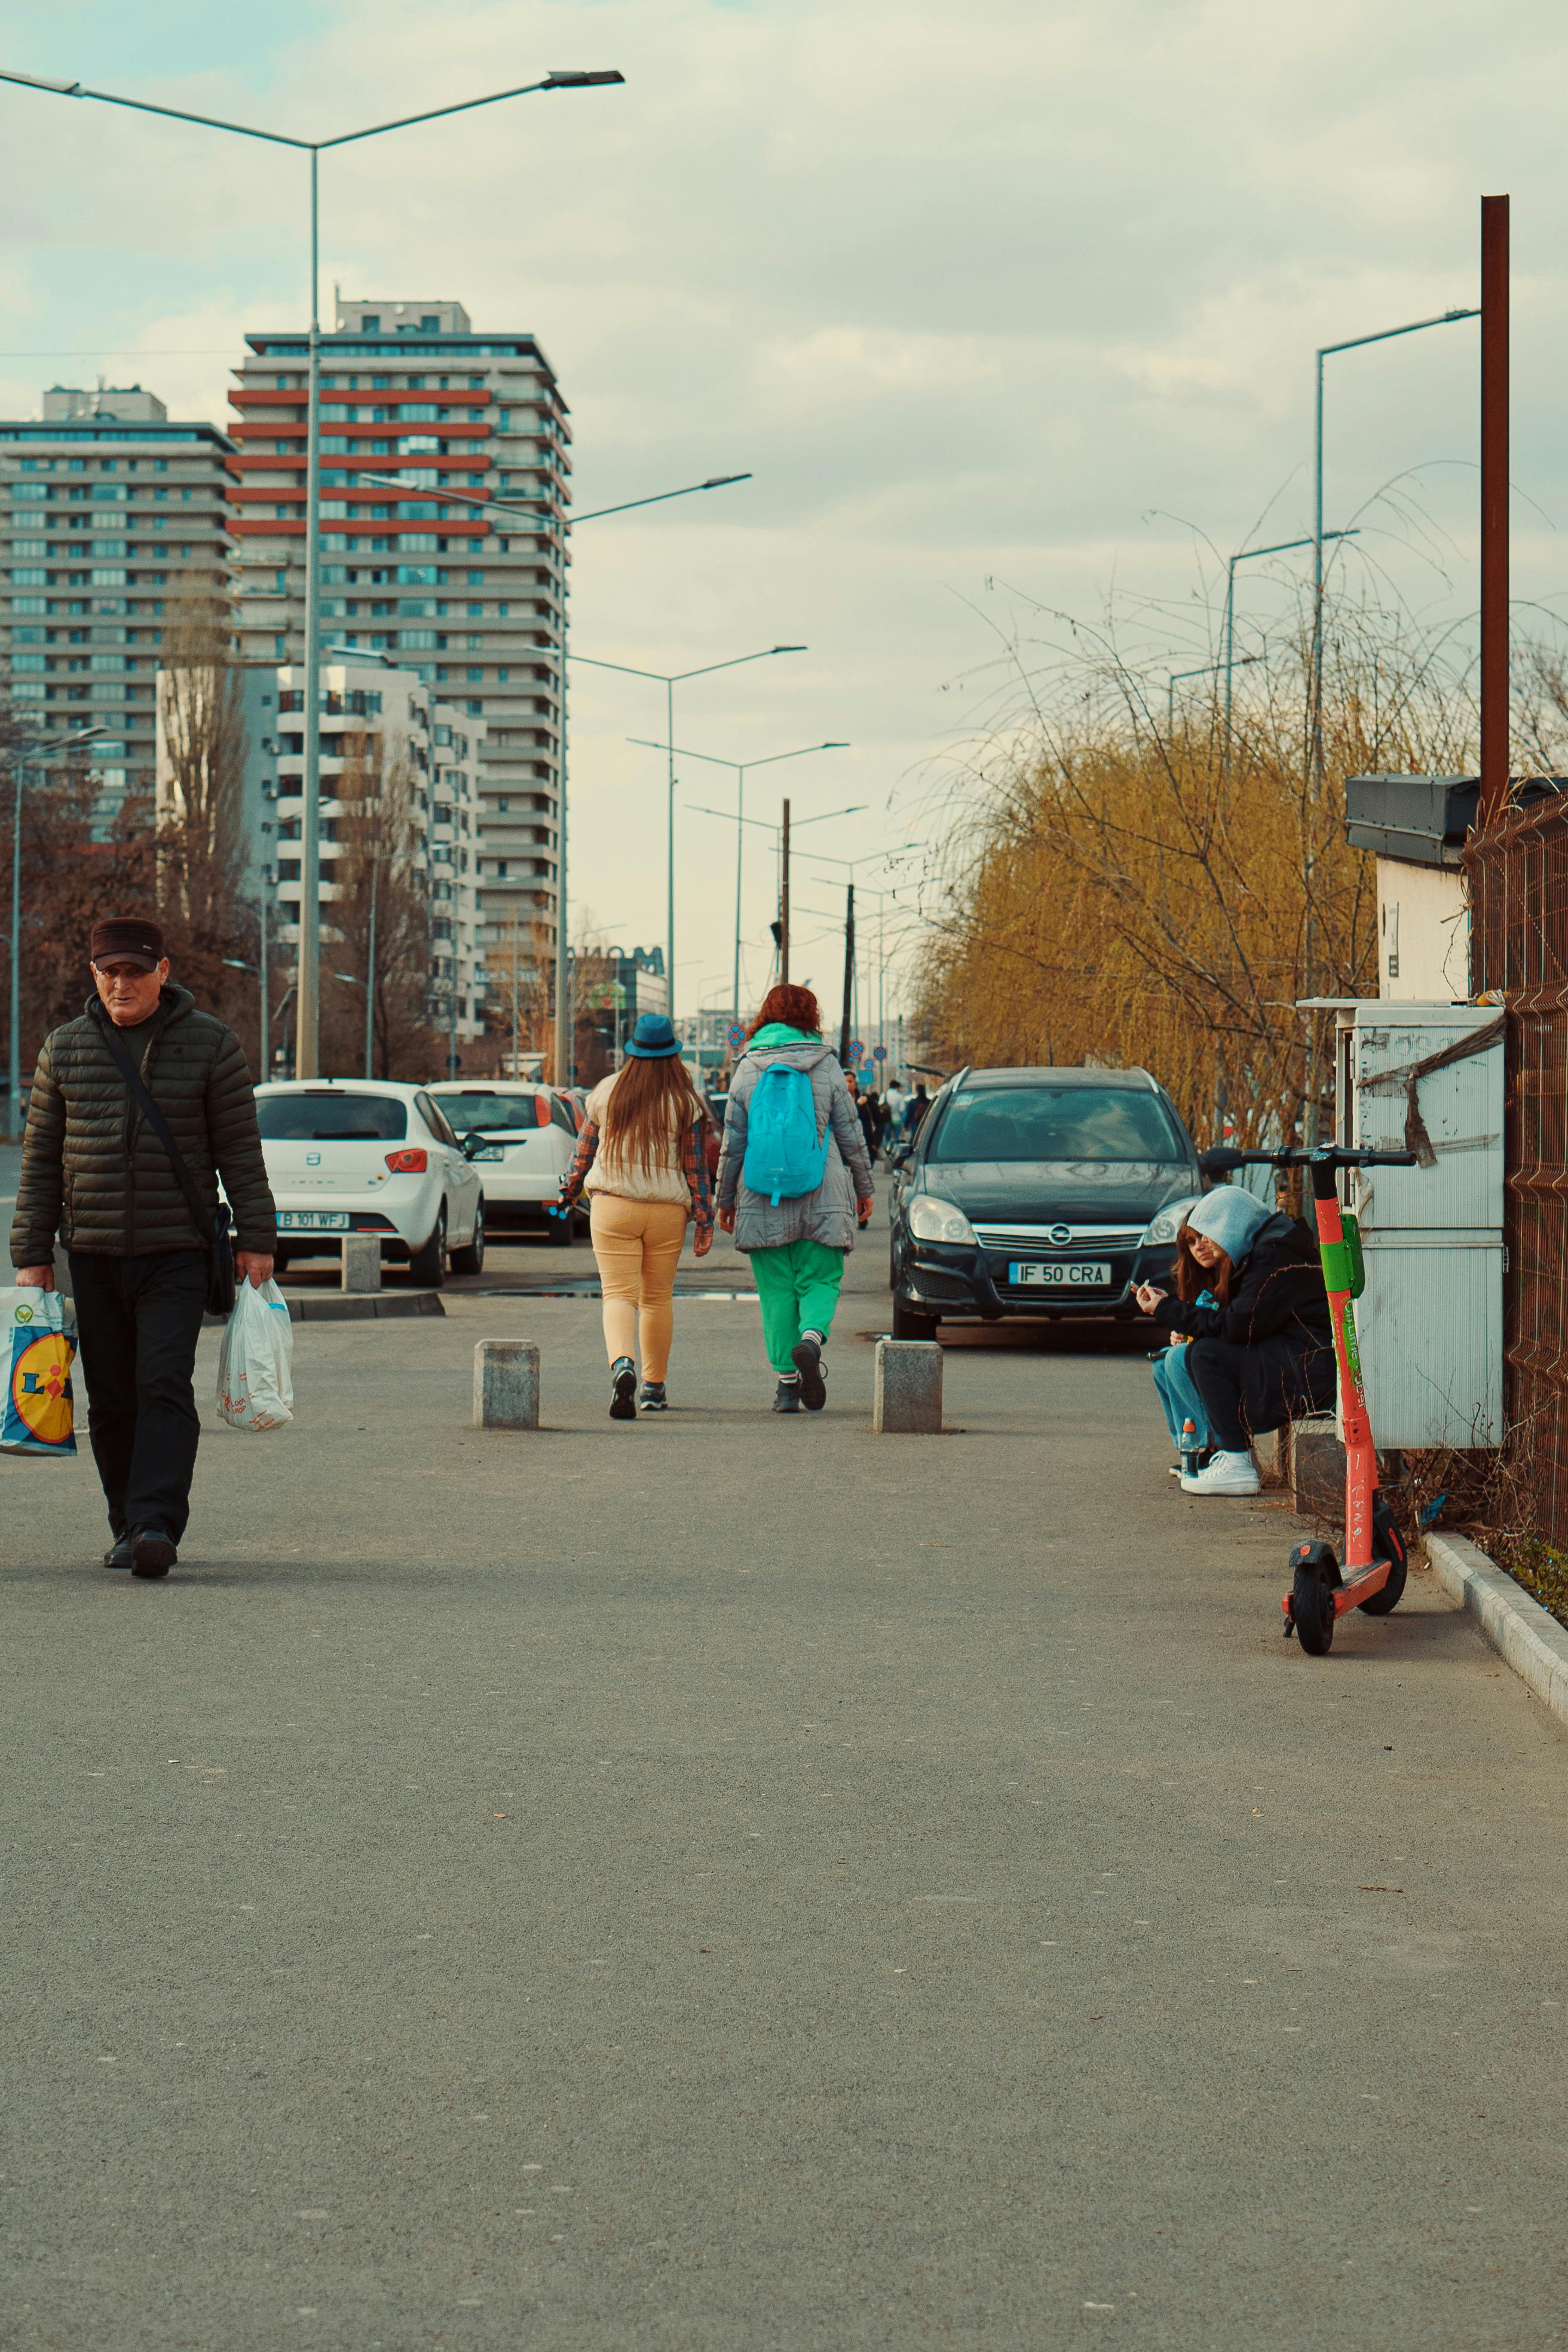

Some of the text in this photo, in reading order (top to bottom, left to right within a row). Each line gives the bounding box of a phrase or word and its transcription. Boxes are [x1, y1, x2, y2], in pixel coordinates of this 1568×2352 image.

[284, 1214, 346, 1227] B 101 WFJ
[1020, 1266, 1103, 1282] IF 50 CRA
[1348, 1325, 1358, 1359] Lime
